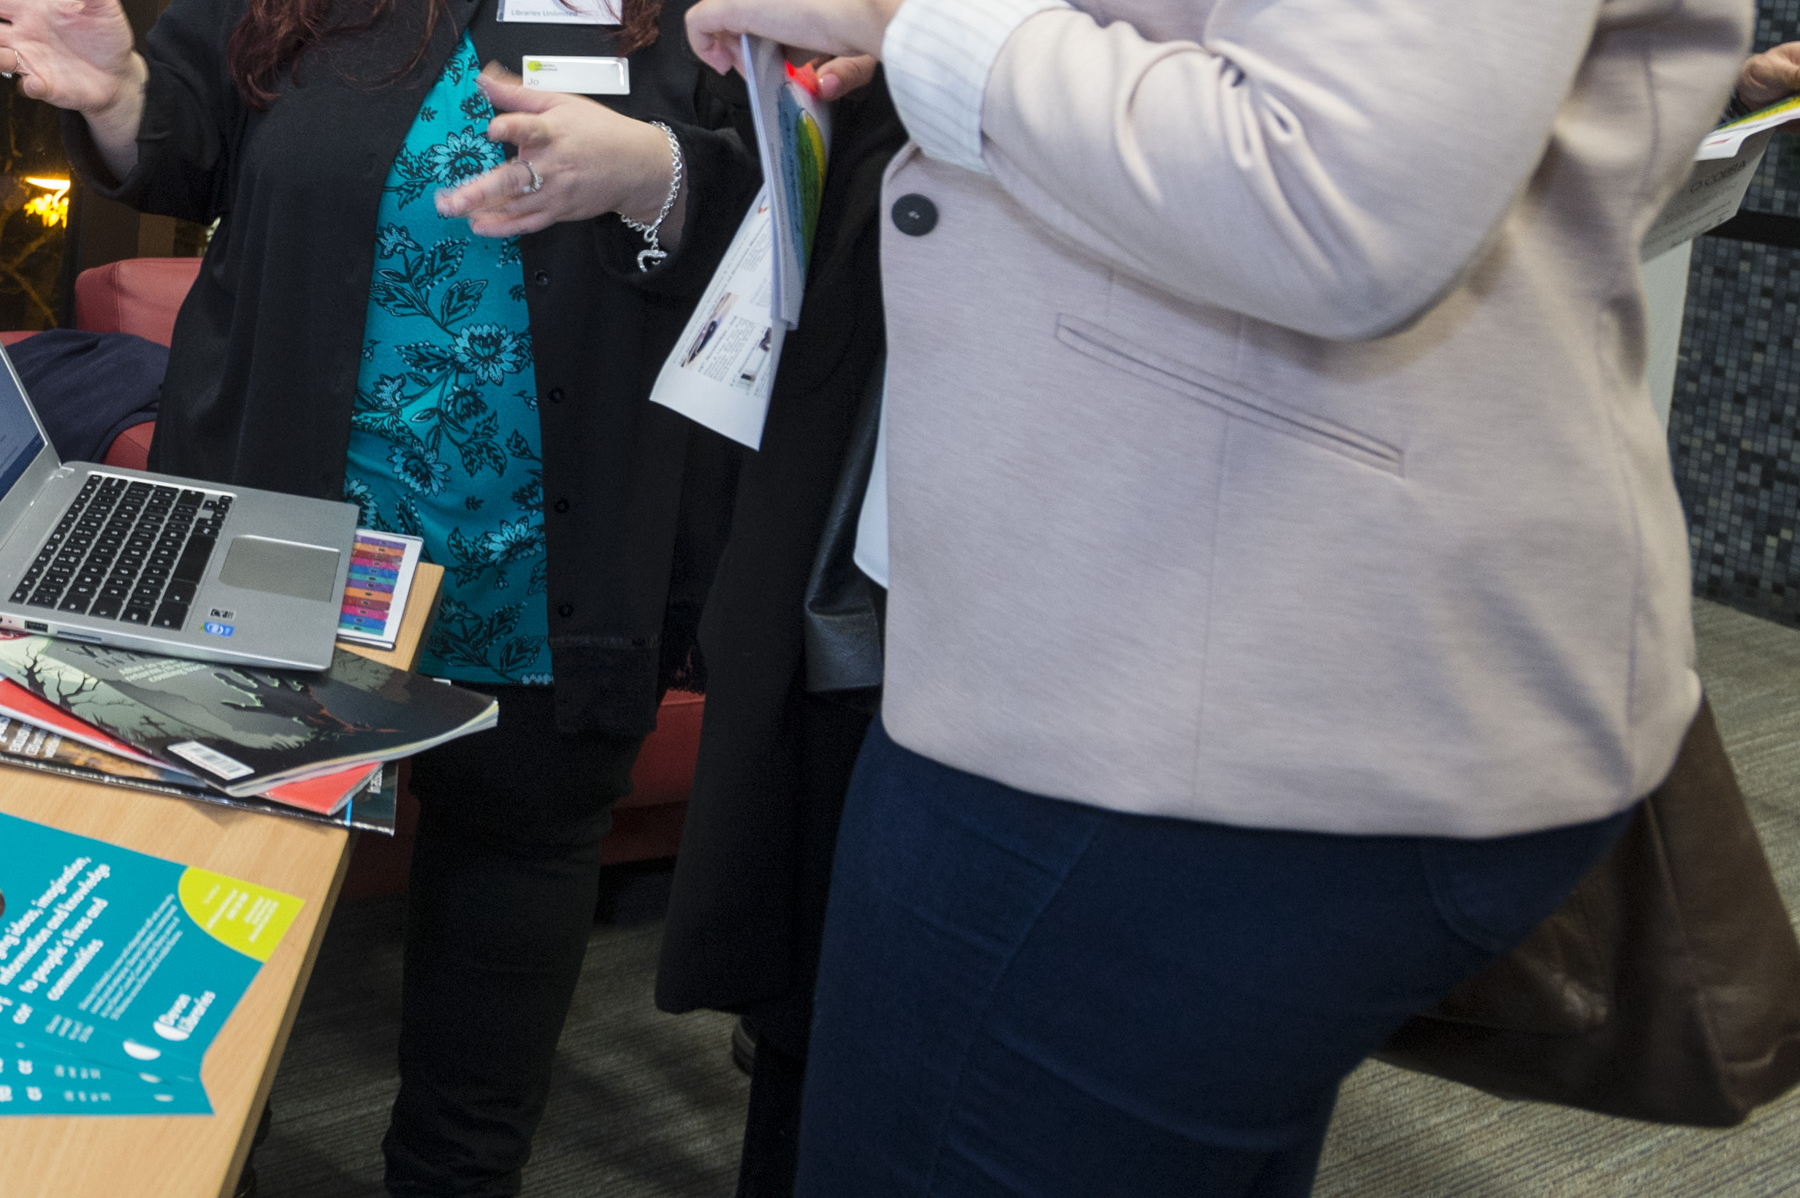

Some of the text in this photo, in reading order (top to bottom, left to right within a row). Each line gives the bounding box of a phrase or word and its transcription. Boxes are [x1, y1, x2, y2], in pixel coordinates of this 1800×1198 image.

[527, 78, 540, 86] Jo
[5, 908, 44, 937] ideas,
[30, 856, 92, 909] imagination,
[58, 863, 111, 913] knowledge
[47, 907, 70, 930] and
[18, 896, 109, 994] to people's lives and
[47, 939, 104, 1002] communities
[158, 994, 192, 1026] Devon
[177, 990, 217, 1033] Libraries
